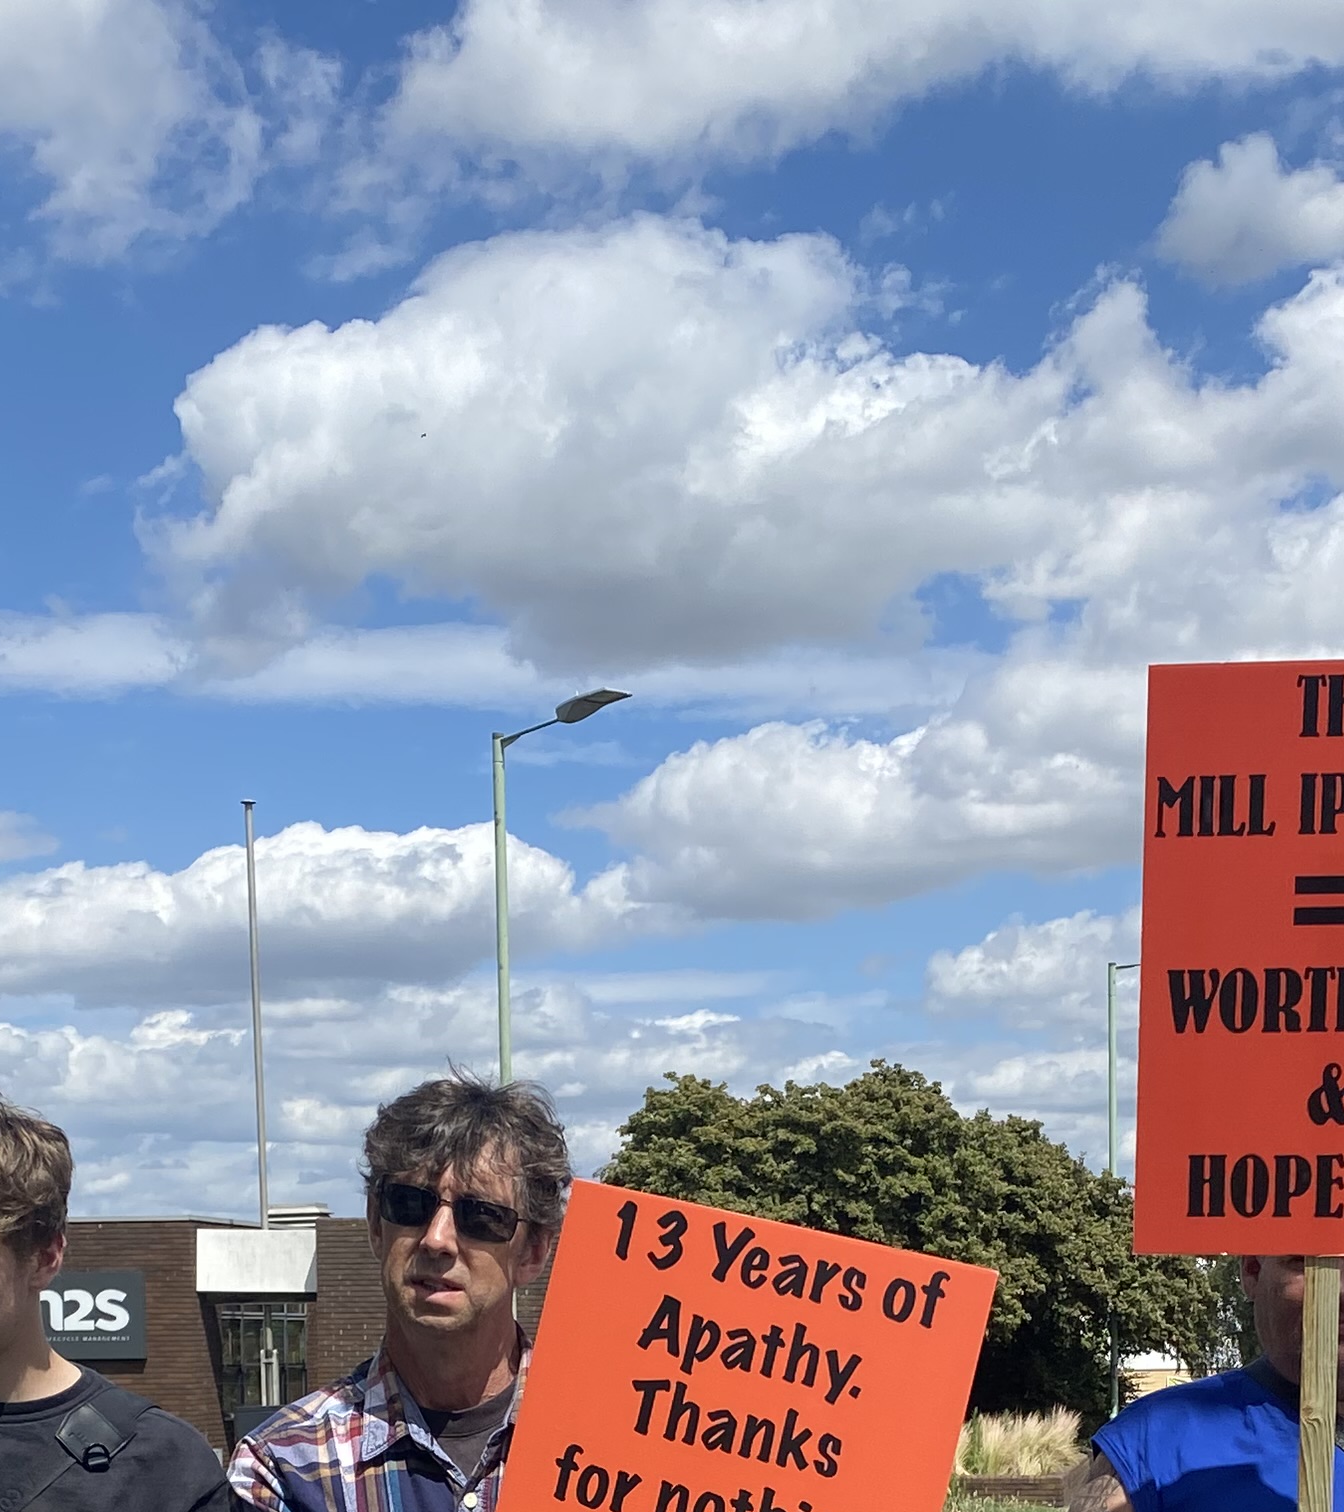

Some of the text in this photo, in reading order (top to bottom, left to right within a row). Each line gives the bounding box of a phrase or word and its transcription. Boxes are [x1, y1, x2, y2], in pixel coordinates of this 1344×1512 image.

[1154, 774, 1276, 838] MILL
[616, 1201, 949, 1328] 13 Years of
[637, 1295, 862, 1404] Apathy.
[631, 1378, 842, 1478] Thanks
